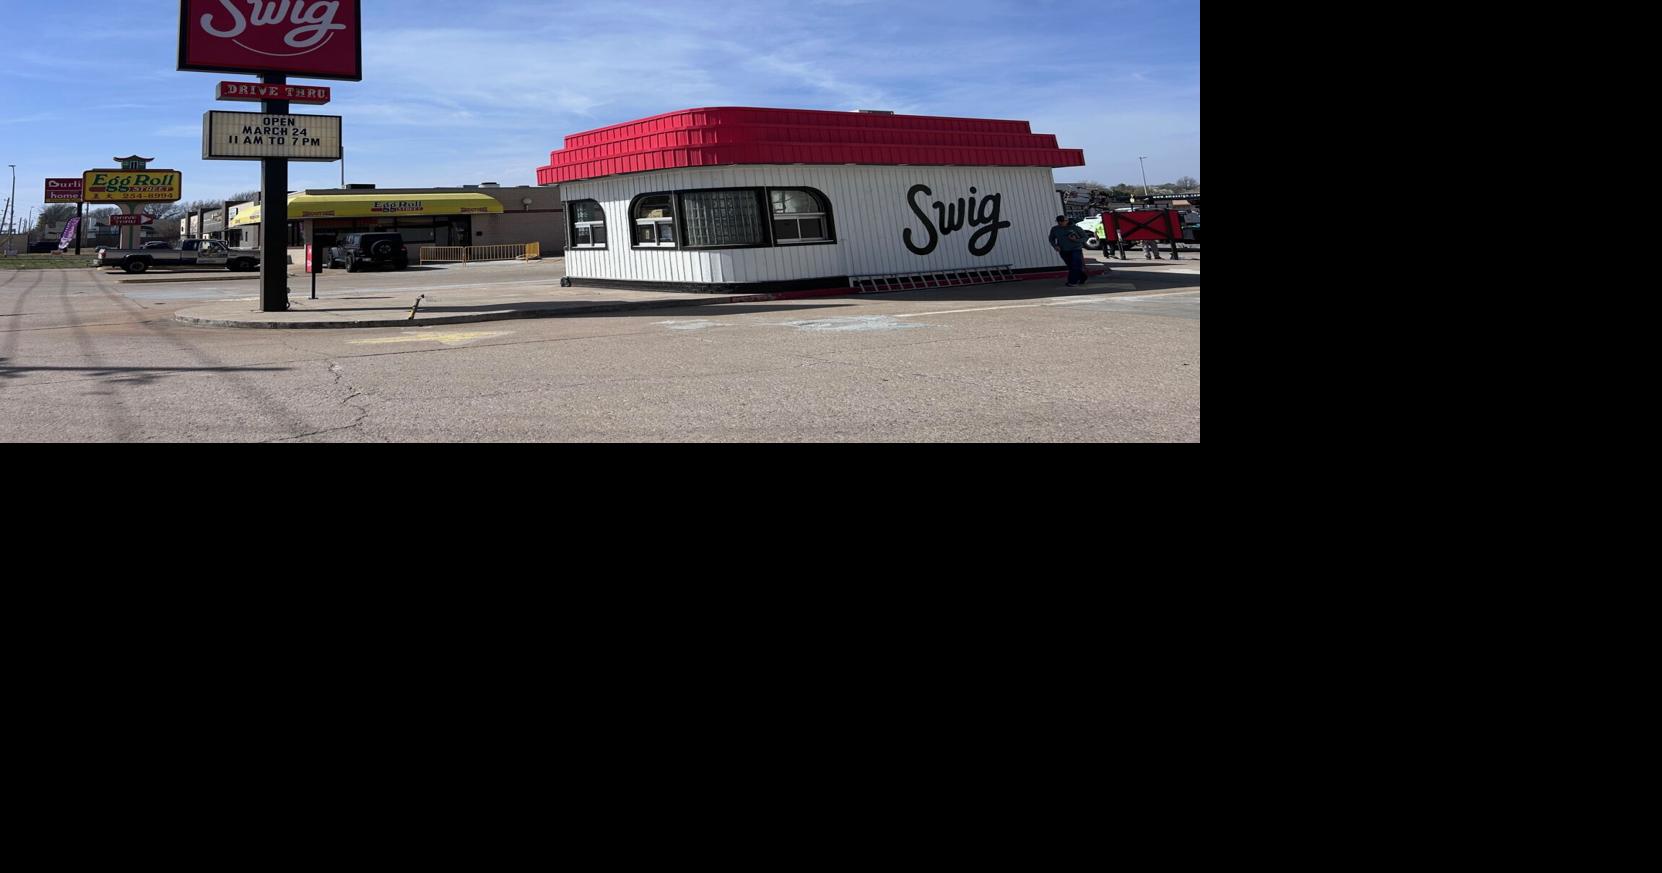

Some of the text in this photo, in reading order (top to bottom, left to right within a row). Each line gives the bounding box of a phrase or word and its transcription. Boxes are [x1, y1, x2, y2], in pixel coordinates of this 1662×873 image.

[200, 0, 347, 48] Swig
[226, 83, 326, 98] DRIVE THRU
[263, 117, 295, 127] OPEN
[242, 126, 307, 136] MARCH 24
[228, 135, 320, 146] 11 AM TO 7 PM
[92, 173, 174, 192] Egg Roll
[902, 183, 1011, 257] Swig
